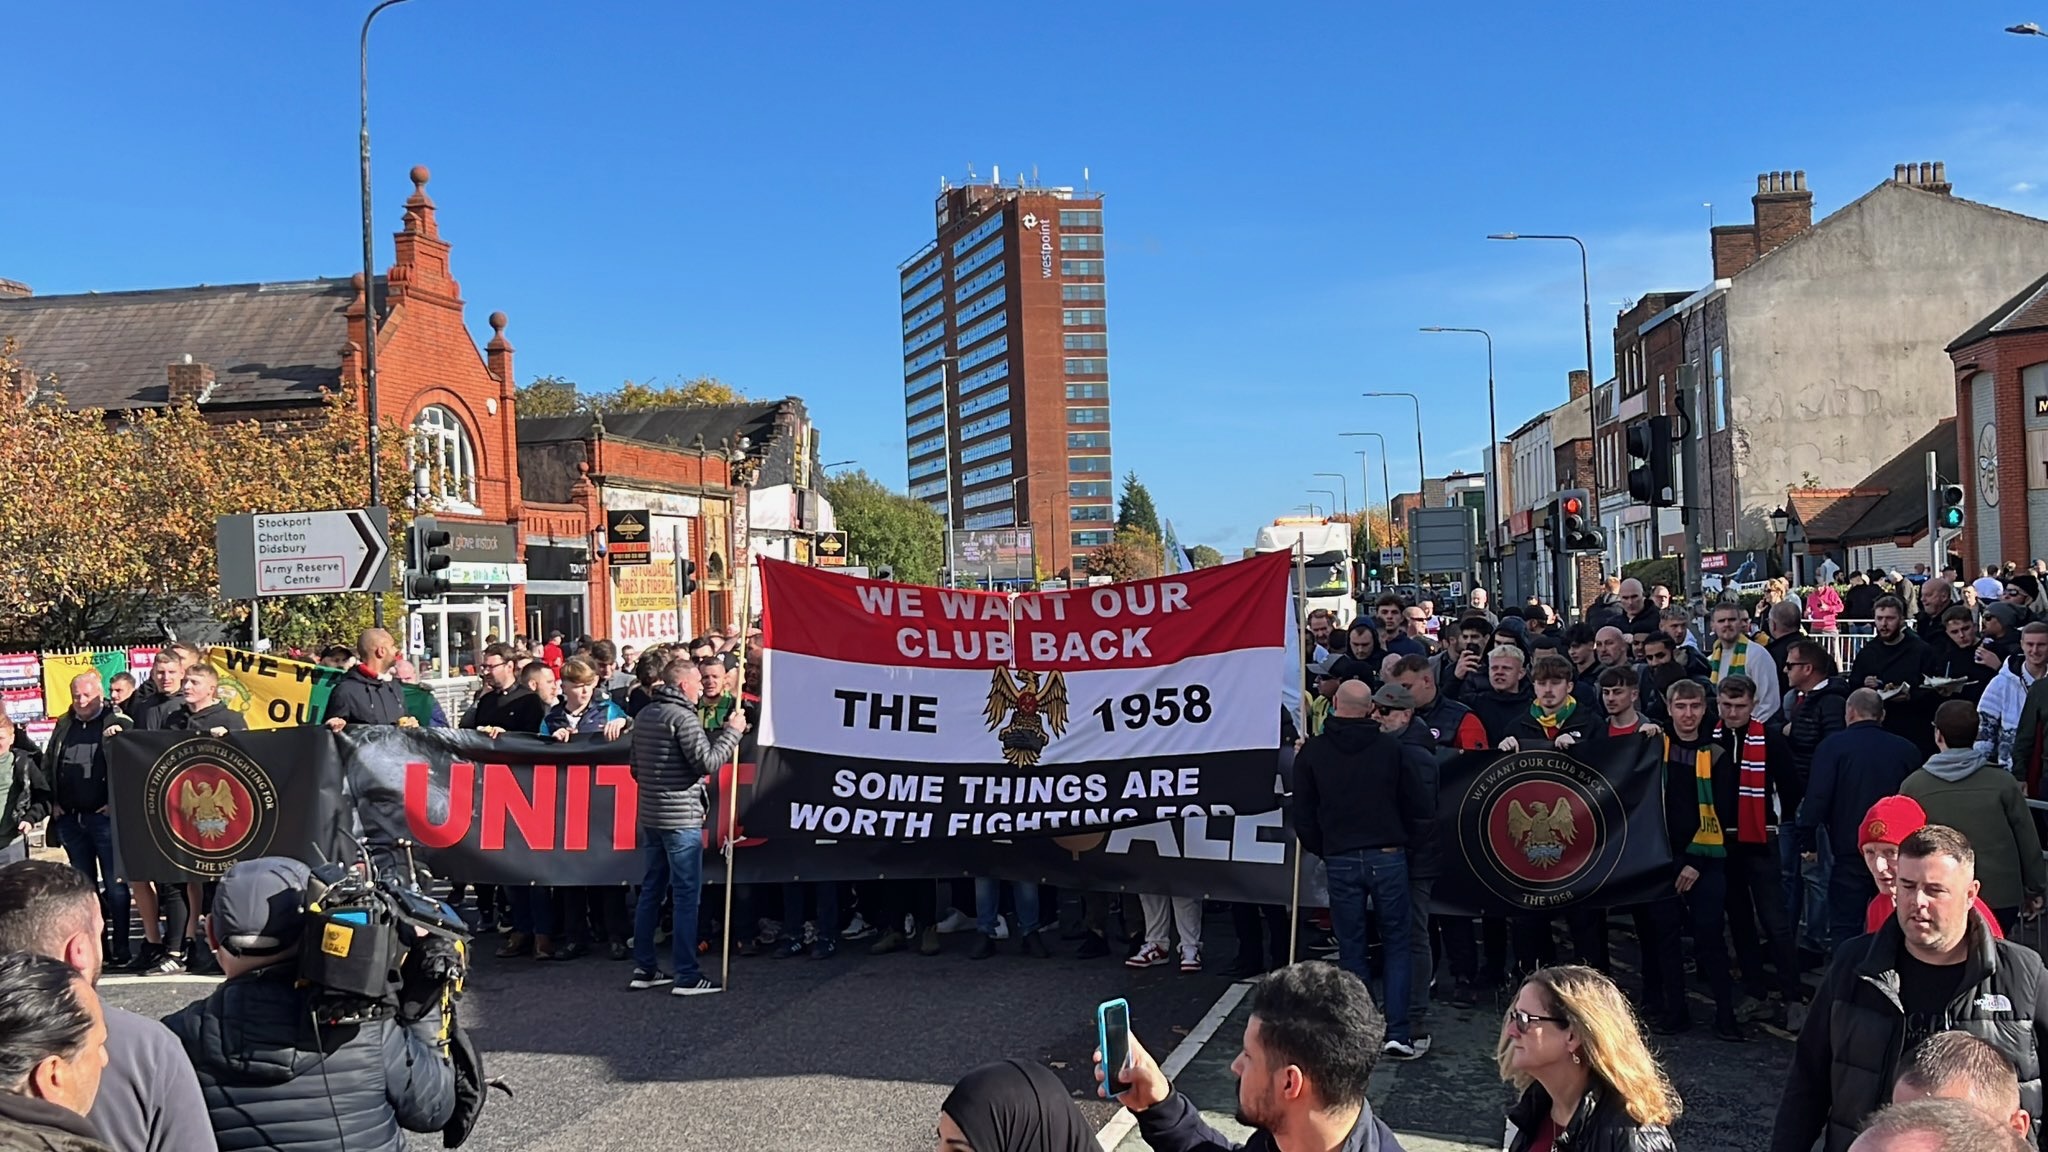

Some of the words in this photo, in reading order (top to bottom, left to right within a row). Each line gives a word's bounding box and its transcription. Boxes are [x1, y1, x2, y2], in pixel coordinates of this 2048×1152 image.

[1040, 219, 1053, 278] westpoint
[258, 516, 312, 528] Stockport
[258, 532, 306, 542] Chorlton
[259, 544, 307, 554] Didsbury
[264, 564, 293, 574] Army
[297, 562, 340, 573] Reserve
[284, 575, 321, 585] Centre
[645, 579, 677, 594] FIREPLA
[855, 585, 925, 617] WE
[938, 591, 1071, 621] WANT
[1091, 582, 1192, 618] OUR
[620, 613, 655, 639] SAVE
[896, 627, 1012, 661] CLUB
[1031, 626, 1152, 662] BACK
[65, 654, 112, 665] GLAZERS
[225, 649, 278, 677] WE
[834, 689, 939, 734] THE
[1092, 684, 1213, 732] 1958
[152, 755, 176, 786] THINGS
[178, 745, 195, 759] ARE
[229, 753, 268, 791] FIGHTING
[262, 791, 275, 810] FOR
[832, 769, 945, 803] SOME
[959, 774, 1107, 804] THINGS
[1121, 767, 1200, 799] ARE
[1472, 784, 1488, 802] WE
[1486, 762, 1516, 783] WANT
[1519, 758, 1543, 768] OUR
[1547, 759, 1576, 774] CLUB
[1578, 770, 1605, 795] BACK
[790, 802, 933, 837] WORTH
[195, 861, 216, 872] THE
[1523, 893, 1545, 906] THE
[1549, 890, 1574, 905] 1958
